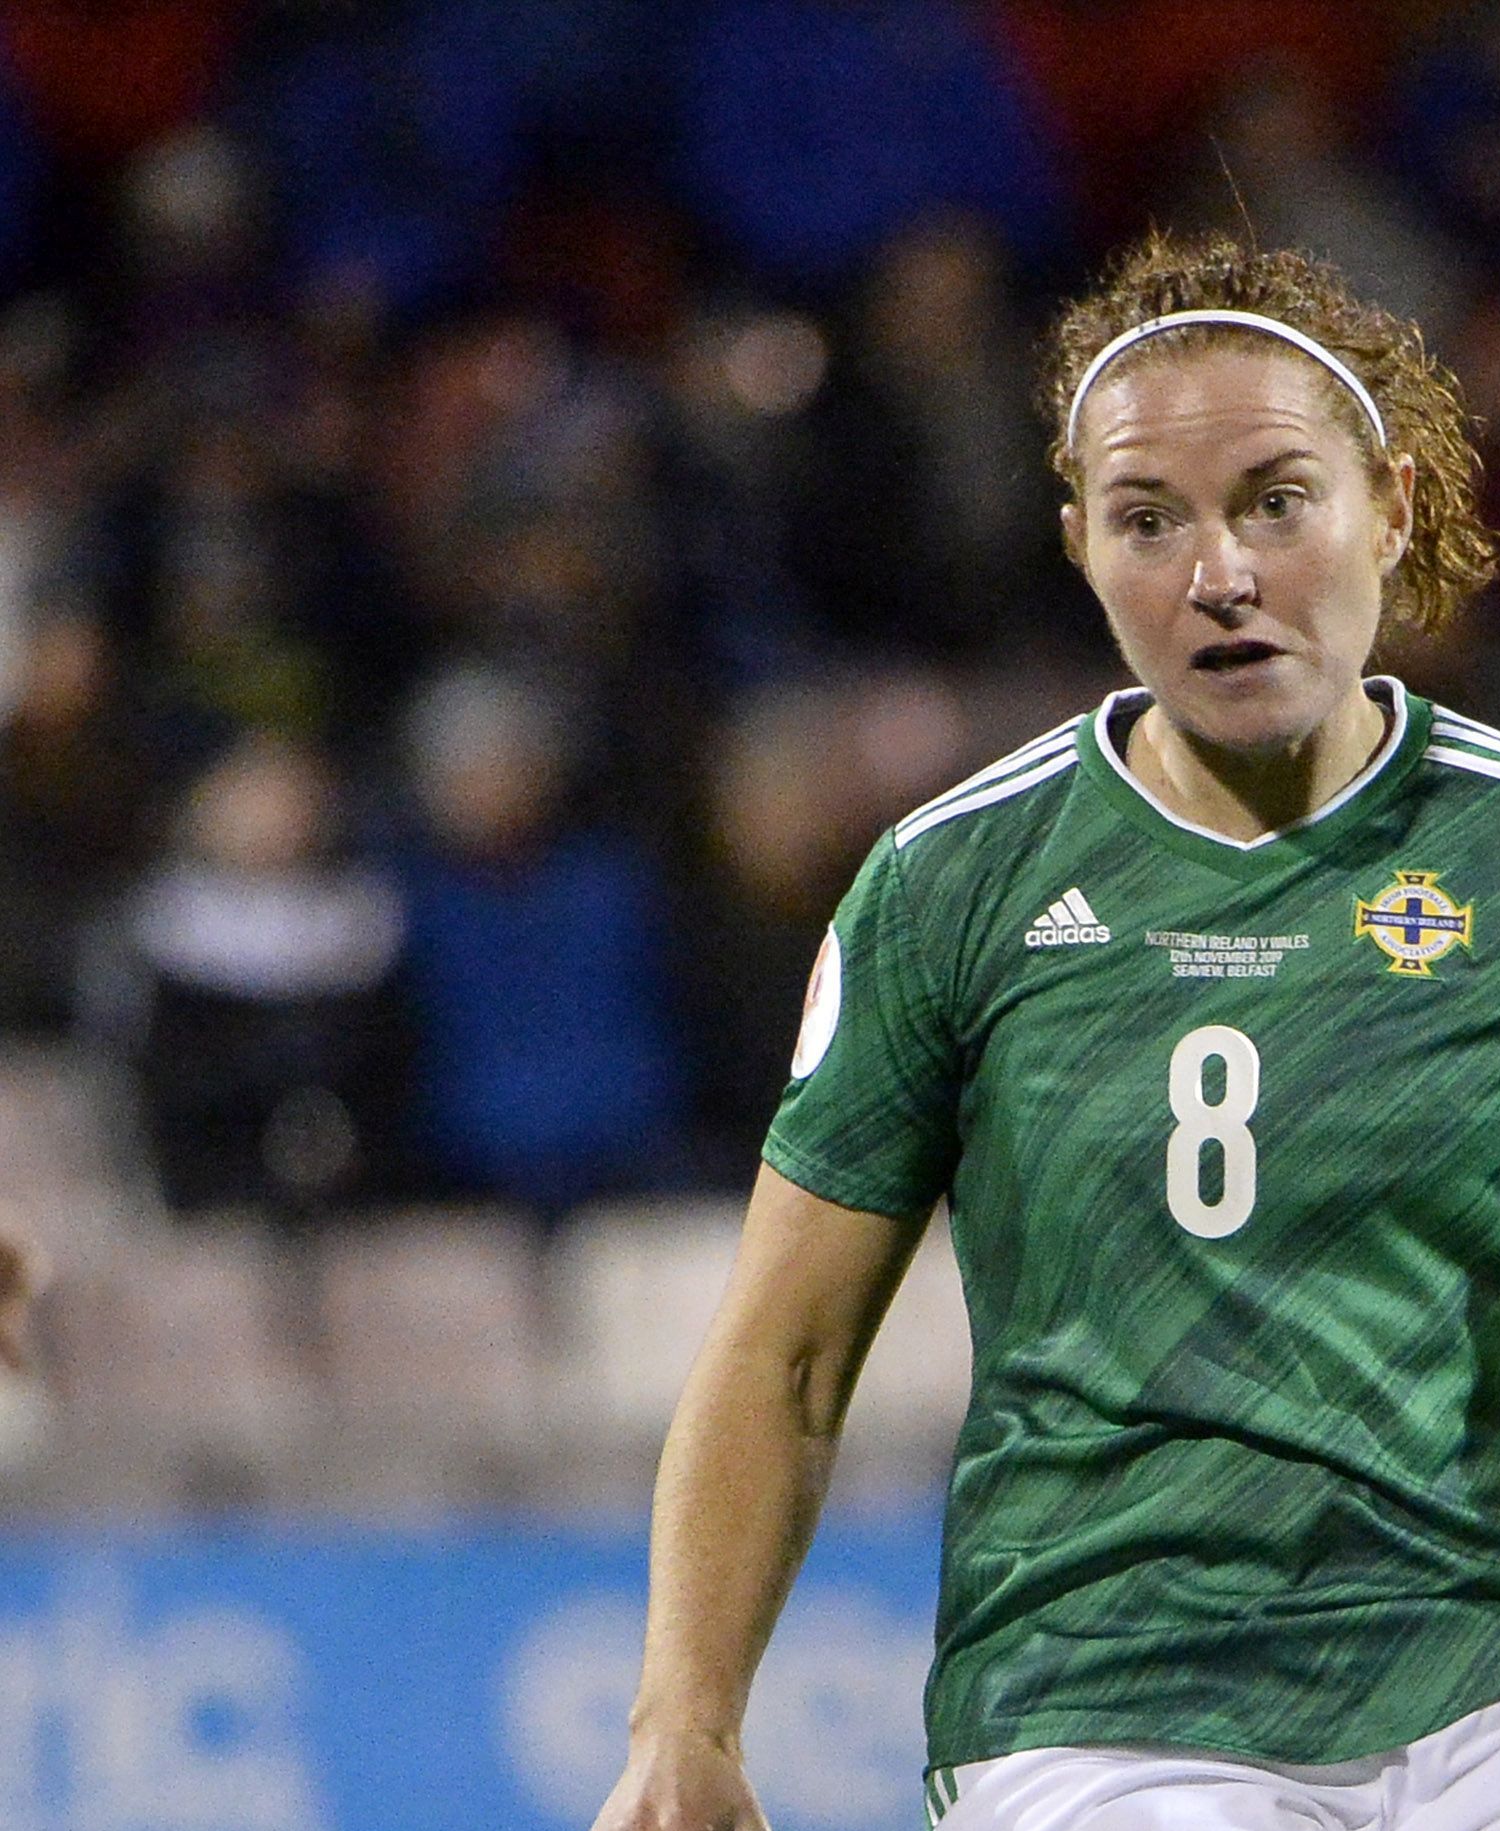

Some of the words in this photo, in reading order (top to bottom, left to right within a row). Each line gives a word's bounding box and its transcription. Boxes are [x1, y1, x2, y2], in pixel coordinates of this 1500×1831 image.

[1025, 925, 1110, 946] adidas
[1145, 931, 1207, 949] NORTHERN
[1208, 935, 1258, 949] IRELAND
[1259, 936, 1269, 949] V
[1269, 934, 1310, 949] WALES
[1170, 950, 1193, 963] 12th
[1194, 950, 1257, 963] NOVEMBER
[1226, 964, 1277, 977] BELFAST
[1167, 1025, 1260, 1239] 8
